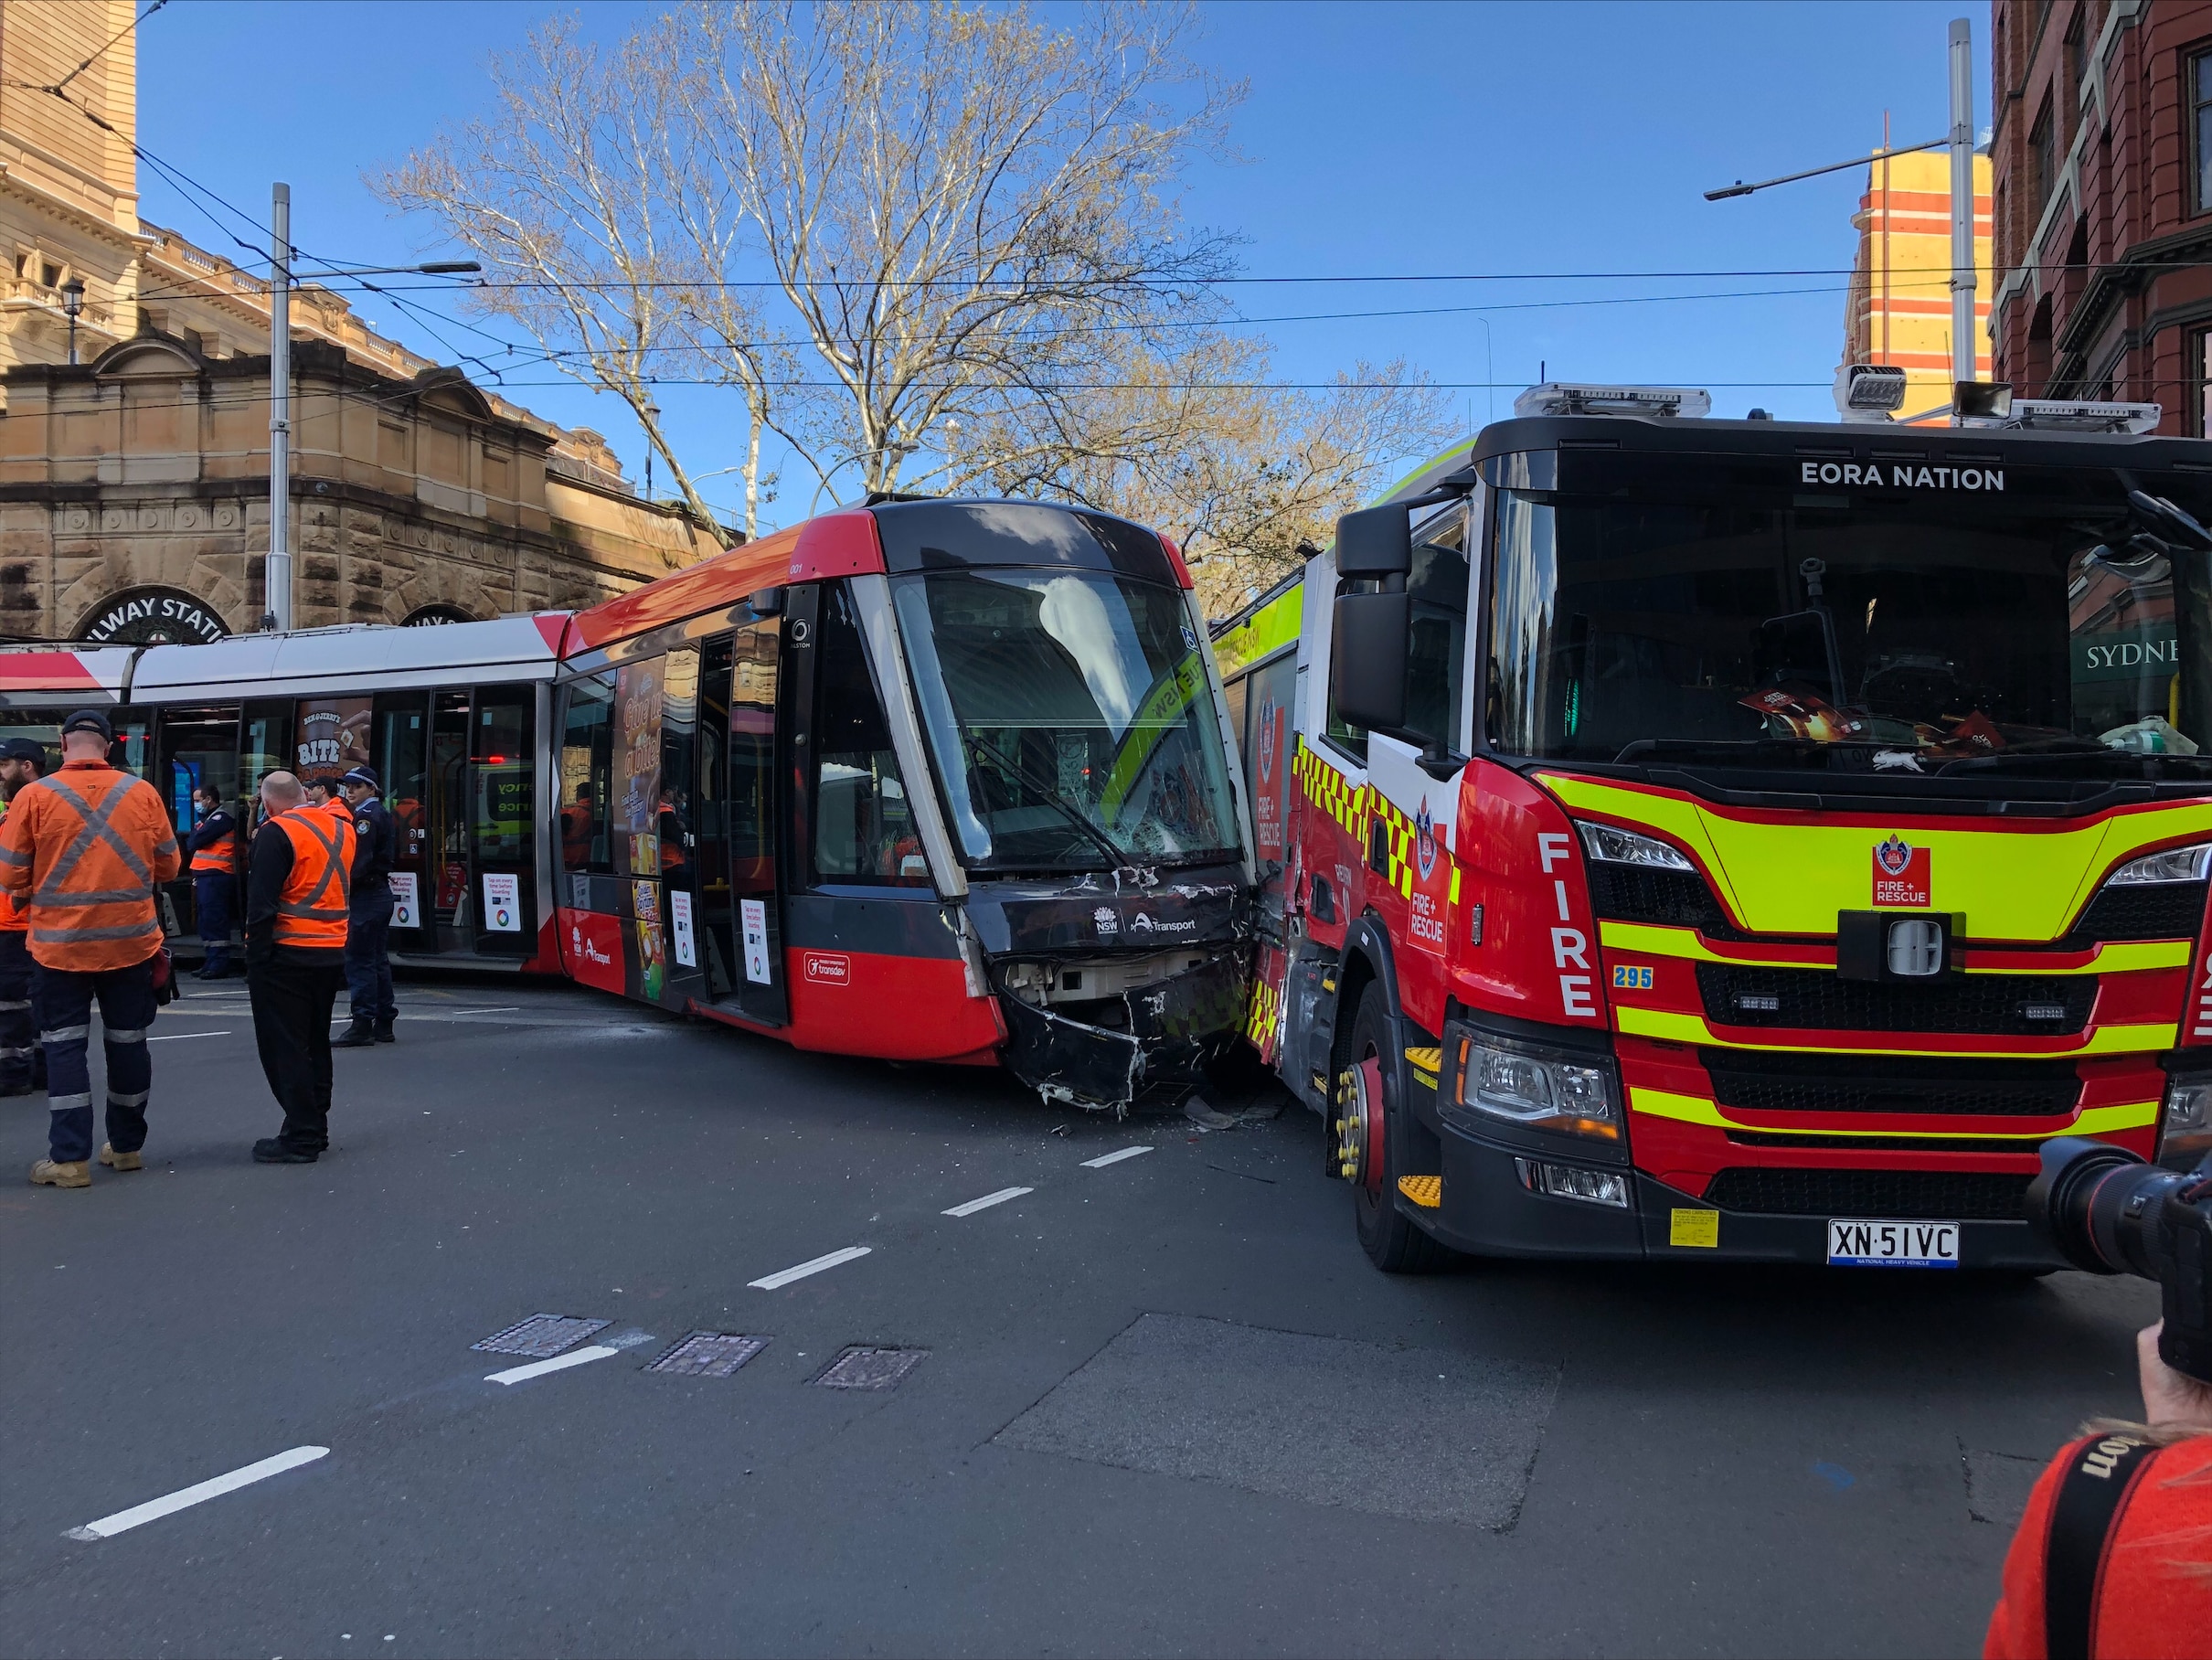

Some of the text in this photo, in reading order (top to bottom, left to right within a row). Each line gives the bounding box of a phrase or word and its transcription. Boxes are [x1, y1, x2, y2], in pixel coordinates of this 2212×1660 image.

[1802, 463, 2005, 491] EORA NATION
[790, 563, 803, 575] 001
[623, 695, 650, 730] Give
[298, 739, 340, 766] BITE
[1877, 880, 1905, 891] FIRE
[1877, 891, 1926, 902] RESCUE
[1412, 892, 1430, 916] FIRE
[1098, 921, 1117, 931] NSW
[1153, 920, 1196, 932] Transport
[1411, 914, 1443, 942] RESCUE
[1537, 833, 1596, 1016] FIRE
[819, 964, 845, 976] transdev
[1614, 966, 1652, 988] 295
